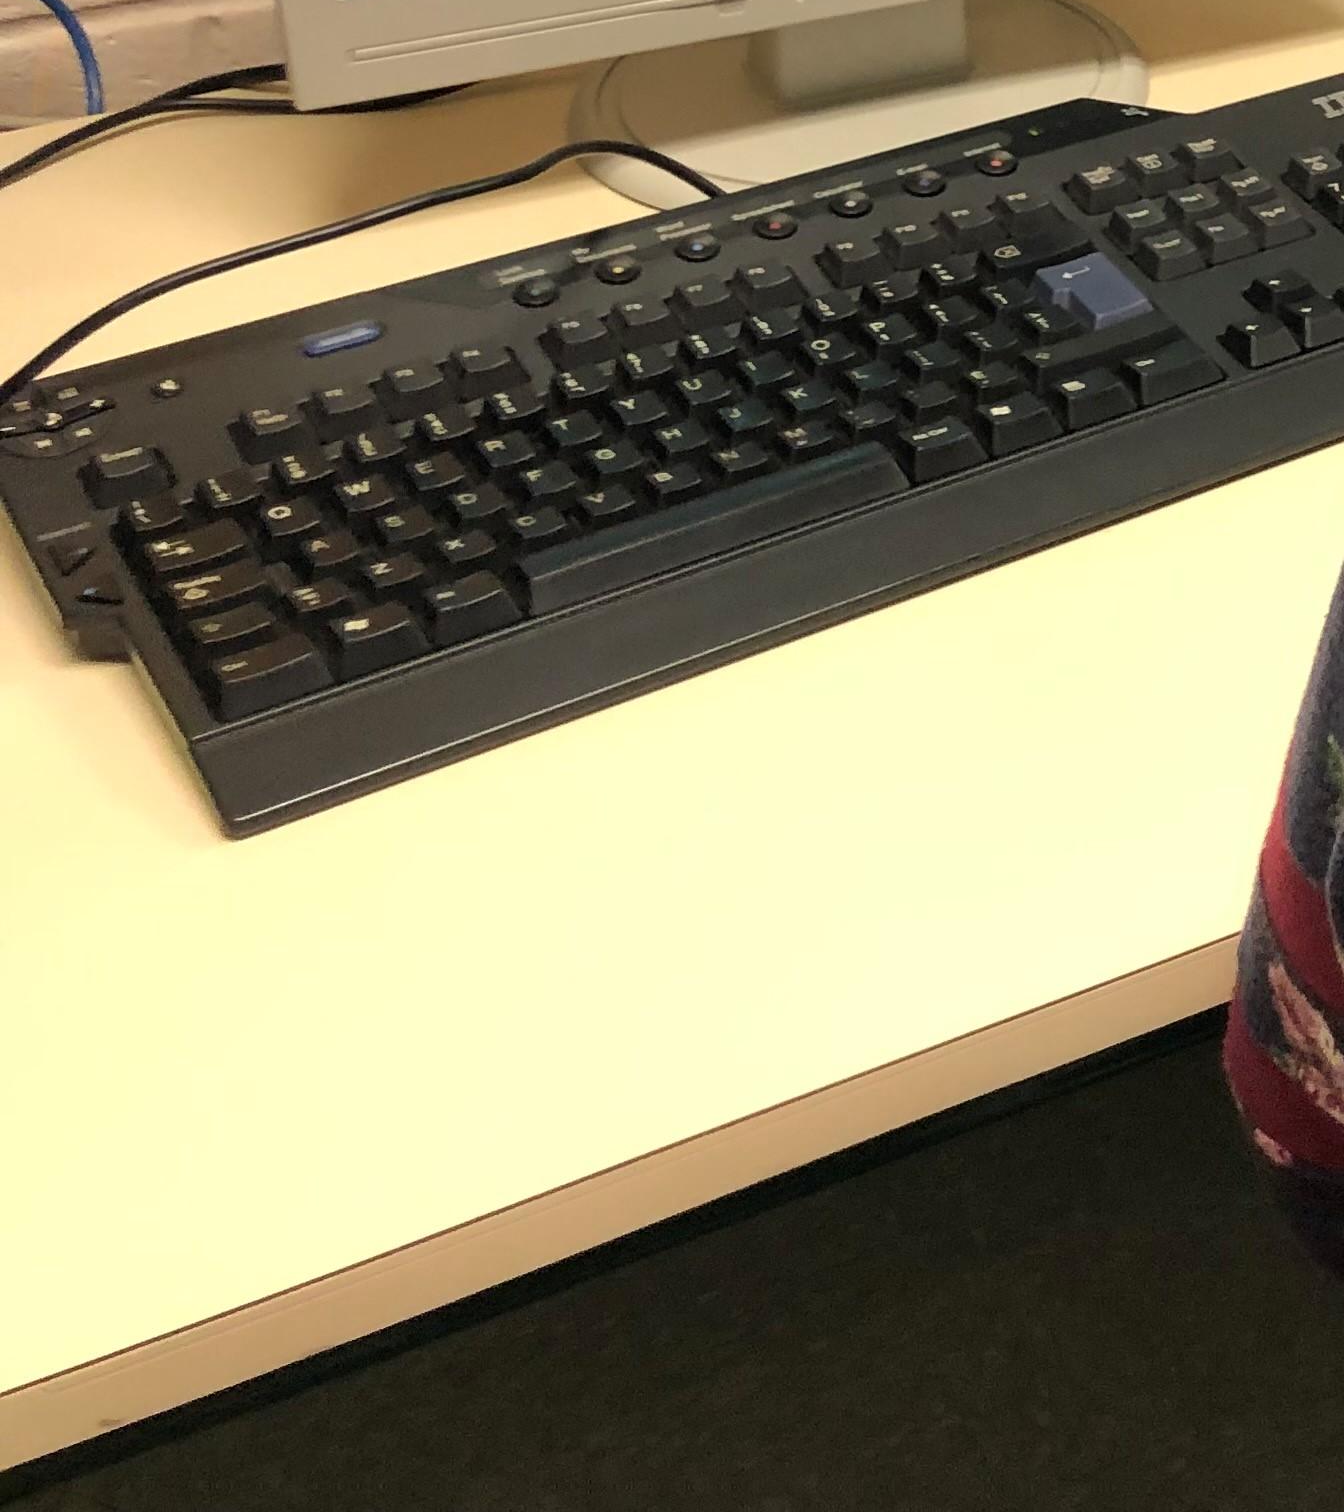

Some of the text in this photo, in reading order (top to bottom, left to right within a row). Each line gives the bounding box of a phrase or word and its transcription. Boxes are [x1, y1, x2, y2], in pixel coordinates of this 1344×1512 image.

[811, 340, 831, 351] O
[682, 378, 703, 390] U
[618, 398, 636, 410] Y
[552, 419, 569, 431] T
[661, 428, 682, 440] H
[414, 460, 435, 475] E
[526, 469, 543, 482] F
[344, 480, 371, 496] W
[583, 492, 605, 504] V
